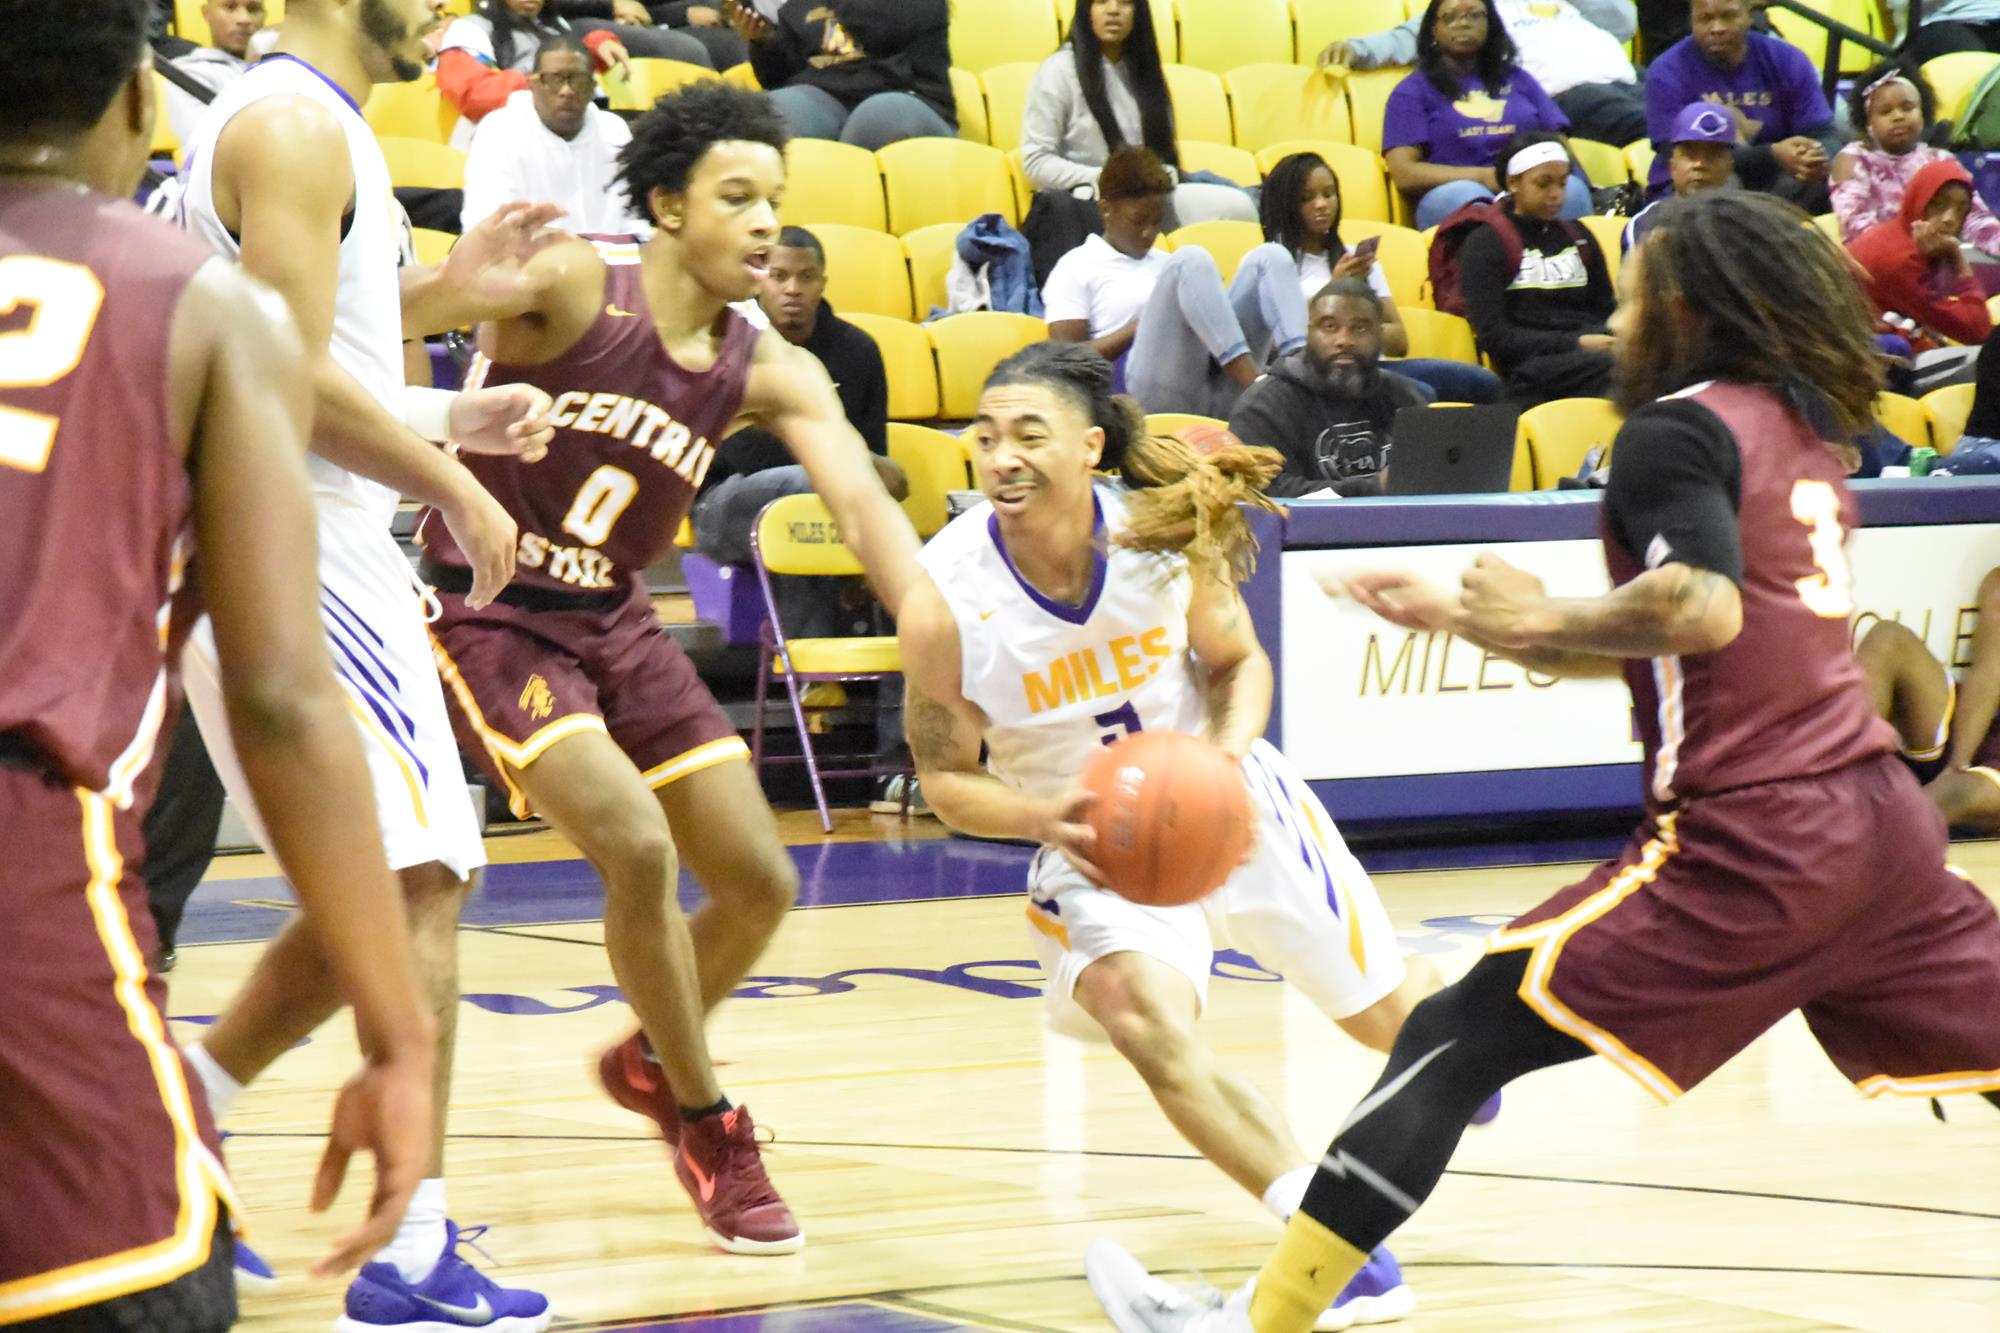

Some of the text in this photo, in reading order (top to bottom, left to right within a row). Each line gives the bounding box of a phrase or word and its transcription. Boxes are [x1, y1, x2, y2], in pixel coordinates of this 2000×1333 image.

[562, 464, 640, 548] 0
[1790, 479, 1855, 618] 3
[1022, 626, 1172, 714] MILES
[1358, 631, 1561, 696] MILE
